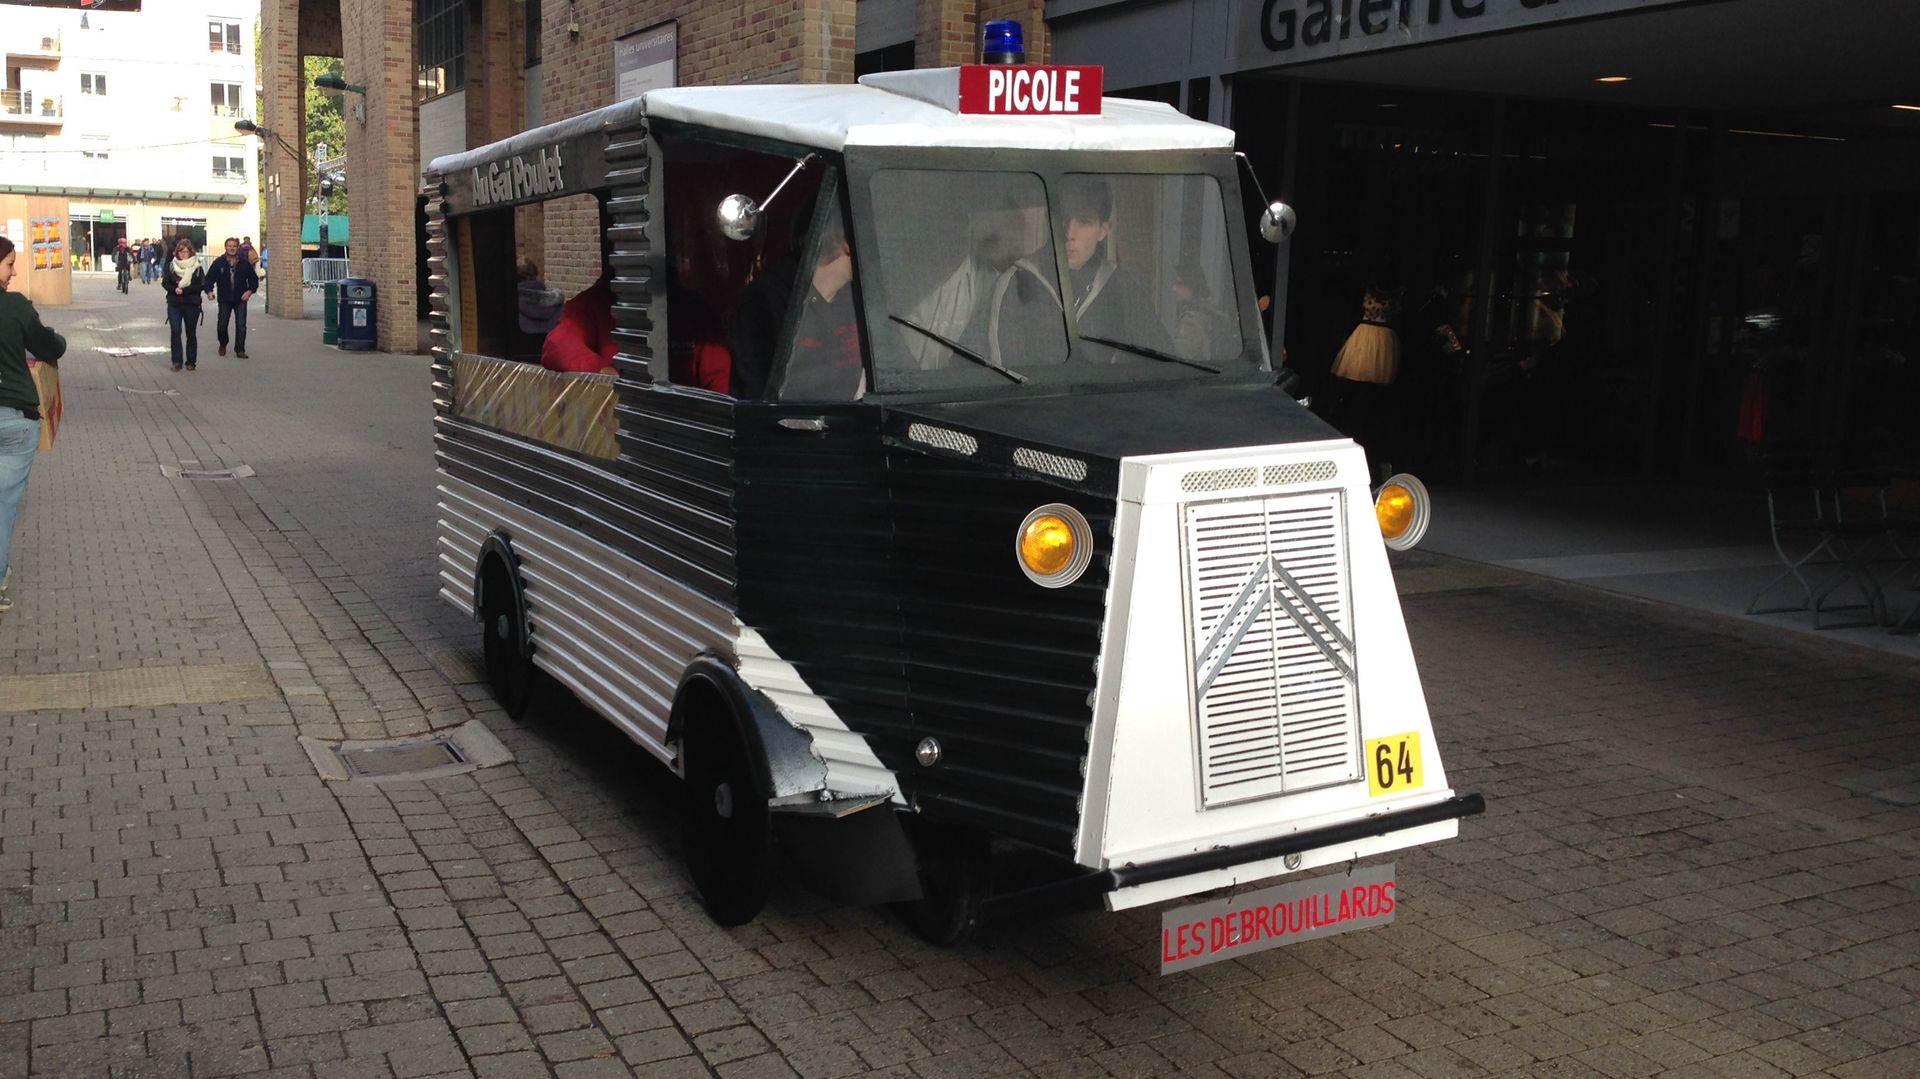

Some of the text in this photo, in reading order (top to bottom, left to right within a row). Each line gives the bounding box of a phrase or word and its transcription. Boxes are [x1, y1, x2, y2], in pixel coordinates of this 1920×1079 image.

[989, 69, 1080, 112] PICOLE
[473, 144, 563, 206] Au Gai Poulet
[1375, 741, 1413, 789] 64
[1163, 882, 1396, 963] LES DEBROUILLARDS
